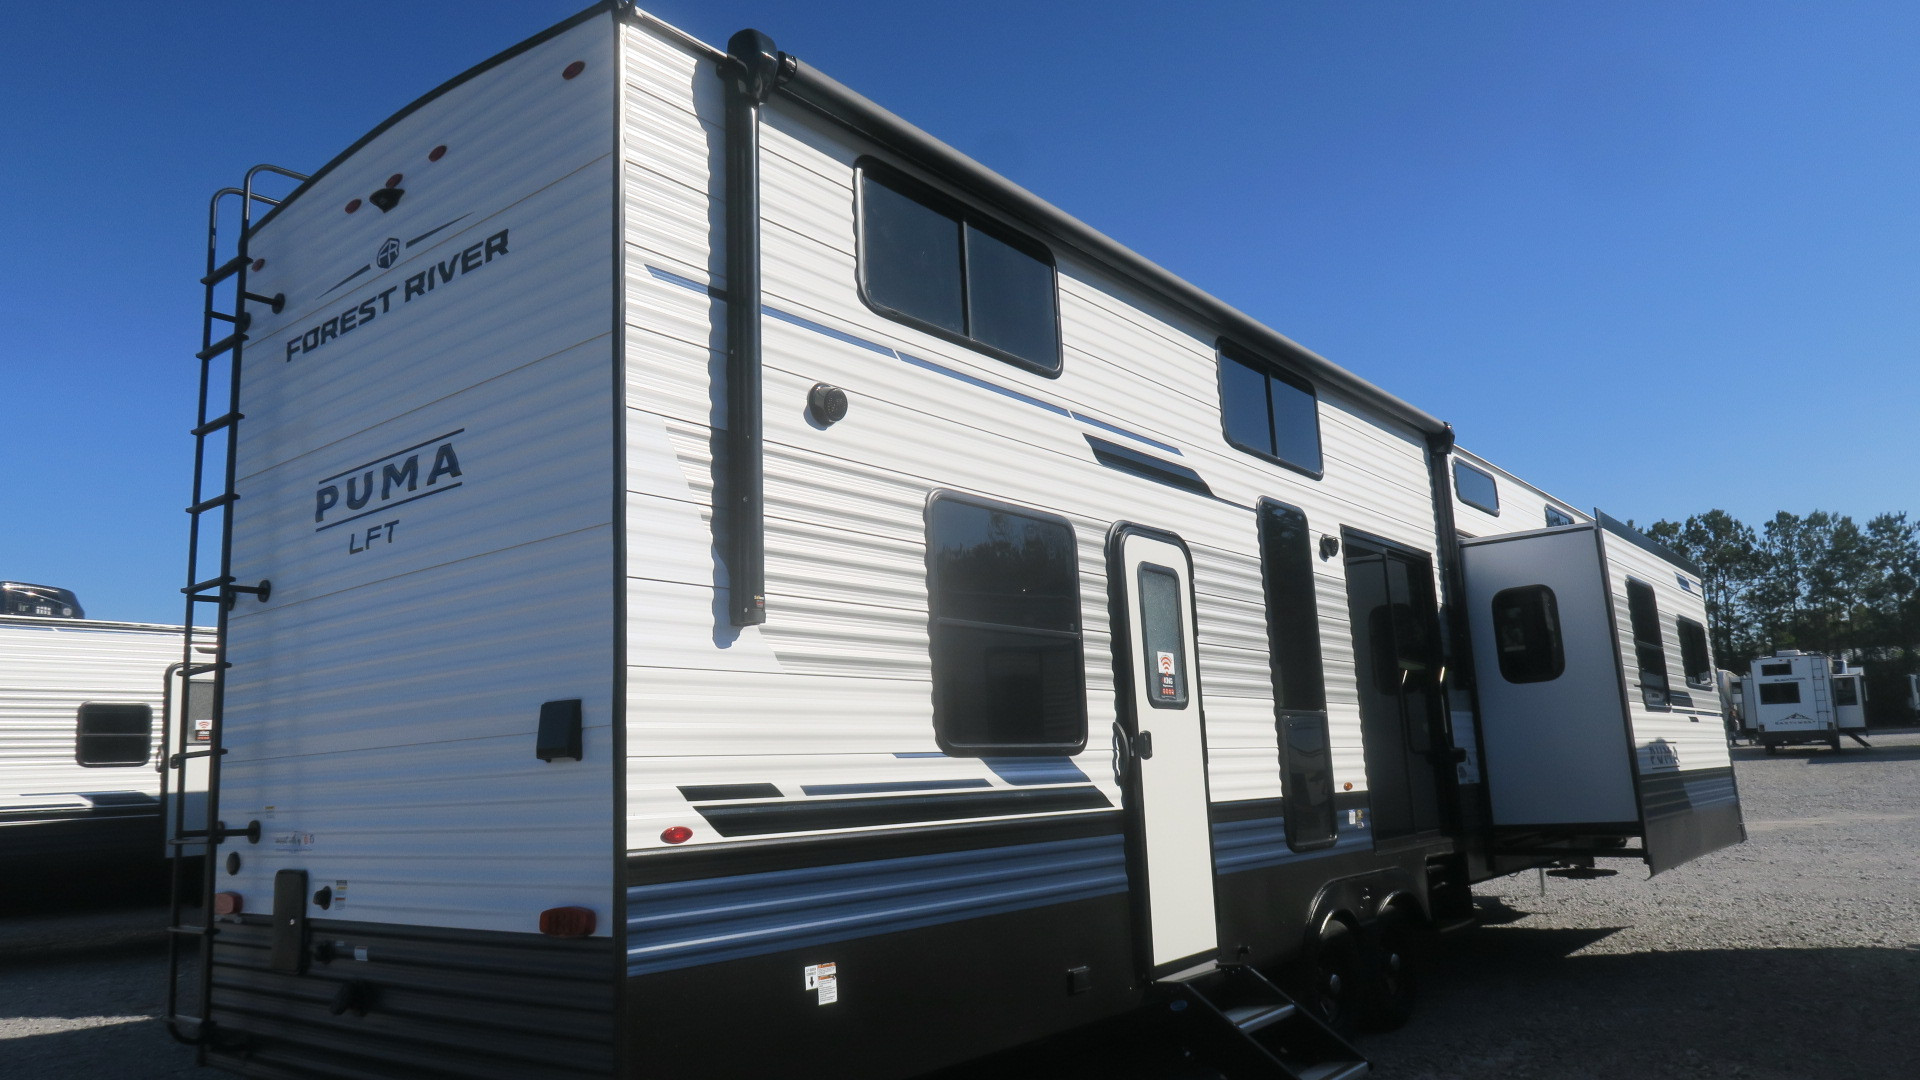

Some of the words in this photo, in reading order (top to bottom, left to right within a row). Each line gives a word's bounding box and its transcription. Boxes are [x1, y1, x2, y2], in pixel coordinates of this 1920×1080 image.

[286, 285, 397, 363] FOREST
[404, 228, 509, 303] RIVER
[315, 442, 463, 523] PUMA
[349, 519, 400, 555] LFT
